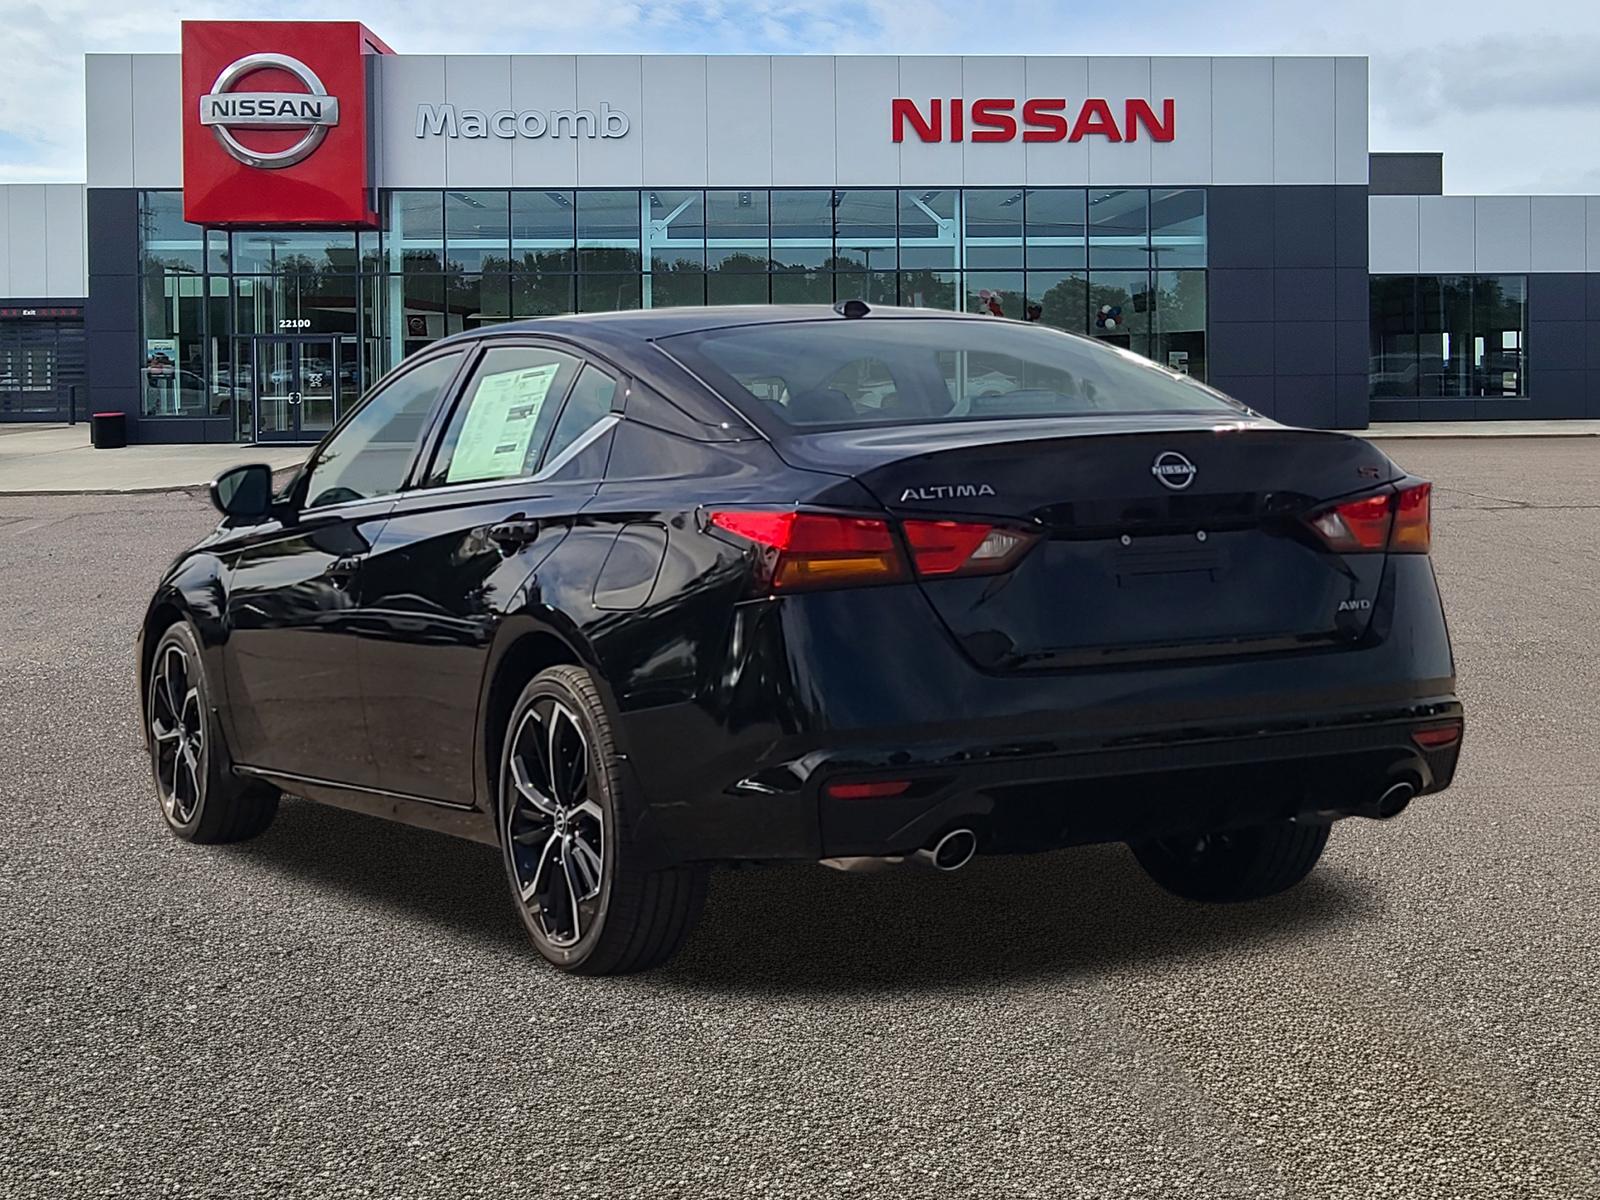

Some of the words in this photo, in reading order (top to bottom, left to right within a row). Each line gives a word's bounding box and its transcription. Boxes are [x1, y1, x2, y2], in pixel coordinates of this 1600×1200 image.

[211, 100, 322, 118] NISSAN
[415, 101, 630, 139] Macomb
[892, 98, 1175, 142] NISSAN
[279, 319, 311, 328] 22100
[900, 484, 996, 501] ALTIMA
[1338, 600, 1371, 611] AWD
